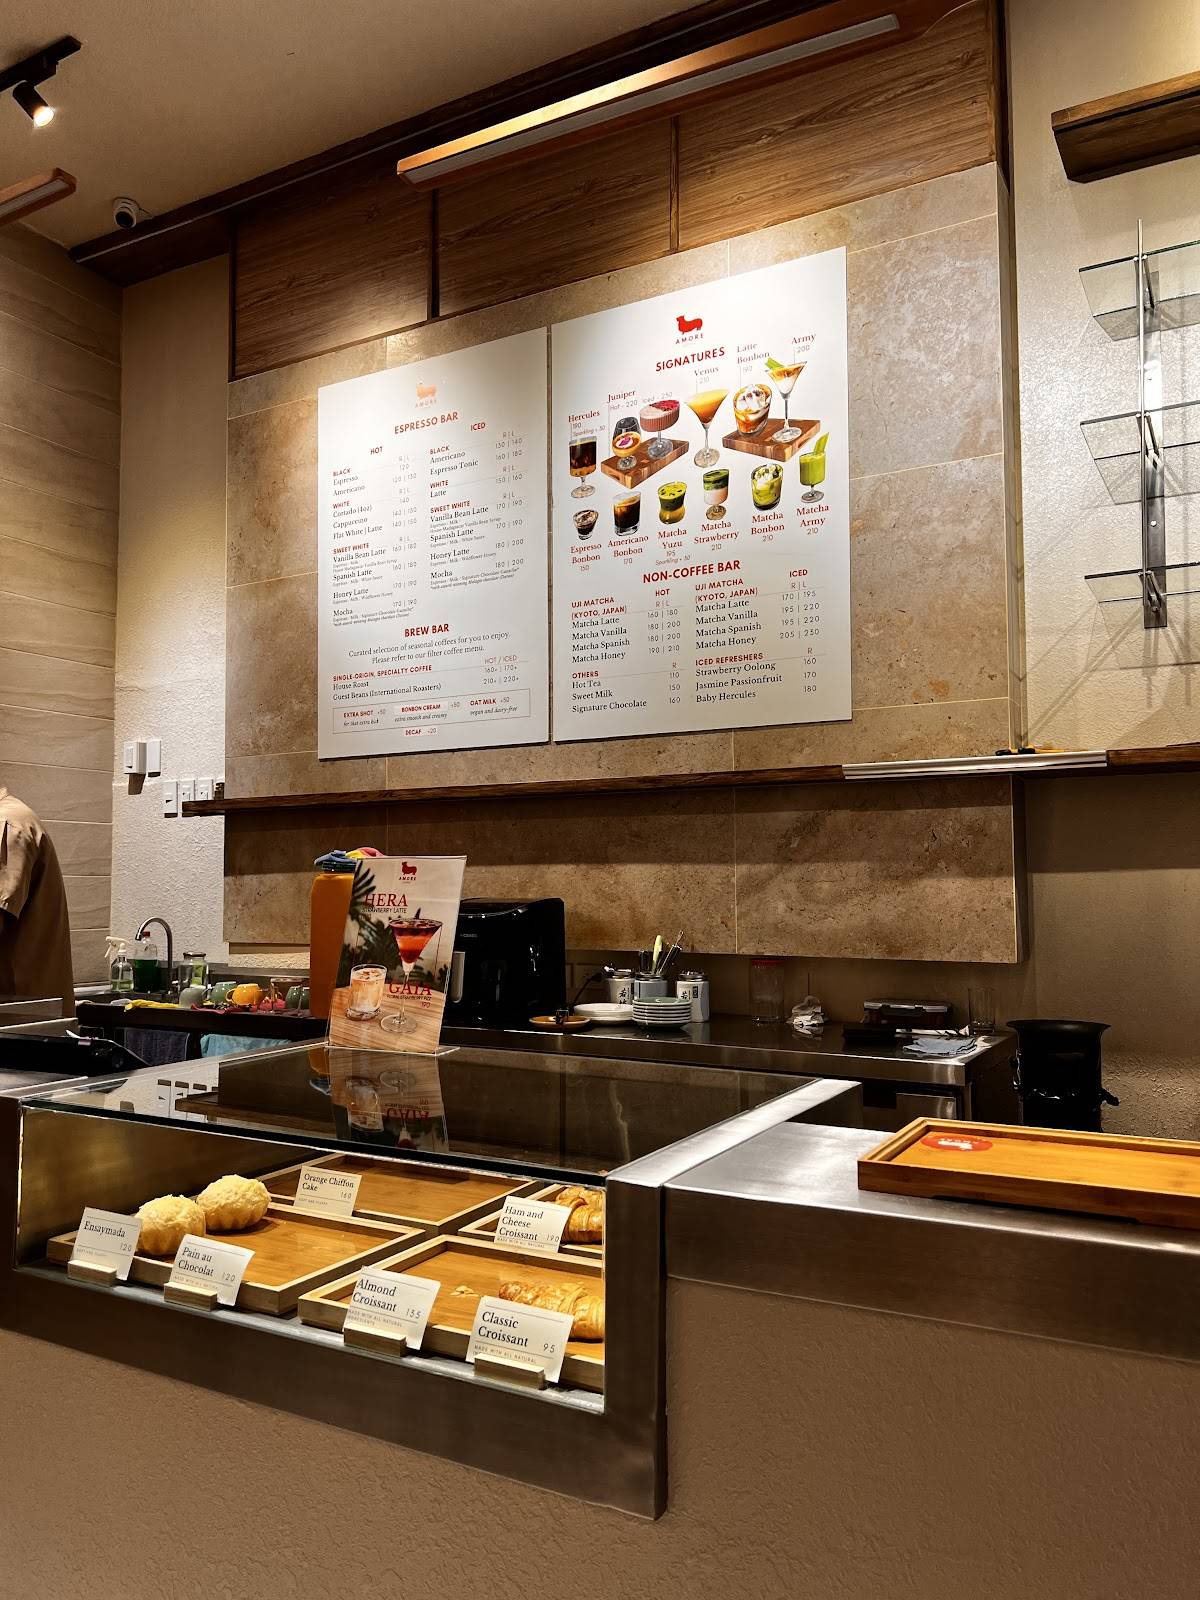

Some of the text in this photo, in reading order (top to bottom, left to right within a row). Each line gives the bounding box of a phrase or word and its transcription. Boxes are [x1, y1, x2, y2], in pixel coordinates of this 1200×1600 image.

[675, 333, 704, 345] AMORE
[792, 333, 816, 345] Army
[737, 342, 758, 353] Latte
[655, 347, 725, 372] SIGNATURES
[737, 351, 770, 364] Bonbon
[694, 366, 719, 376] Venus
[607, 390, 636, 403] Juniper
[394, 411, 458, 434] ESPRESSO BAR
[568, 410, 600, 423] Hercules
[471, 422, 486, 431] ICED
[370, 446, 383, 455] HOT
[430, 446, 450, 455] BLACK
[430, 452, 465, 464] Americano
[430, 459, 478, 476] Espresso Tonic
[430, 480, 449, 489] WHITE
[430, 490, 447, 498] Latte
[430, 500, 471, 513] SWEET WHITE
[796, 504, 829, 516] Matcha
[430, 506, 489, 522] Vanilla Bean Latte
[751, 512, 784, 523] Matcha
[701, 520, 732, 532] Matcha
[800, 517, 826, 527] Army
[430, 531, 455, 542] Spanish
[457, 528, 474, 537] Latte
[658, 528, 687, 539] Matcha
[751, 524, 785, 535] Bonbon
[807, 527, 819, 535] 210
[608, 535, 649, 548] Americano
[693, 530, 739, 544] Strawberry
[570, 543, 602, 554] Espresso
[662, 541, 683, 549] Yuzu
[711, 543, 722, 551] 210
[430, 552, 451, 561] Honey
[453, 548, 470, 556] Latte
[613, 547, 643, 558] Bonbon
[572, 554, 601, 564] Bonbon
[430, 570, 453, 579] Mocha
[643, 560, 741, 583] NON-COFFEE BAR
[789, 569, 808, 578] ICED
[708, 578, 744, 589] MATCHA
[333, 591, 352, 599] Honey
[655, 588, 670, 597] HOT
[695, 587, 758, 603] (KYOTO, JAPAN)
[583, 597, 615, 607] MATCHA
[695, 599, 750, 613] Matcha Latte
[803, 603, 820, 611] 220
[602, 605, 627, 615] JAPAN)
[572, 617, 620, 629] Matcha Latte
[695, 610, 758, 625] Matcha Vanilla
[803, 616, 820, 624] 220
[404, 624, 450, 637] BREW BAR
[572, 627, 627, 640] Matcha Vanilla
[695, 622, 762, 637] Matcha Spanish
[780, 631, 795, 639] 205
[572, 638, 630, 652] Matcha Spanish
[695, 635, 757, 649] Matcha Honey
[572, 651, 626, 664] Matcha Honey
[715, 653, 763, 664] REFRESHERS
[377, 667, 408, 677] SPECIALTY
[409, 664, 432, 673] COFFEE
[572, 671, 599, 679] OTHERS
[695, 662, 776, 677] Strawberry Oolong
[333, 681, 369, 691] House Roast
[572, 679, 601, 689] Hot Tea
[696, 674, 782, 691] Jasmine Passionfruit
[370, 683, 441, 697] (International Roasters)
[804, 685, 817, 693] 180
[572, 690, 613, 701] Sweet Milk
[669, 697, 680, 705] 160
[696, 690, 757, 704] Baby Hercules
[572, 700, 647, 714] Signature Chocolate
[364, 893, 408, 907] HERA
[389, 981, 432, 996] GAIA
[304, 1173, 354, 1188] Orange Chiffon
[302, 1183, 318, 1191] Cake
[340, 1192, 352, 1200] 160
[504, 1206, 544, 1219] Ham and
[501, 1216, 531, 1228] Cheese
[83, 1220, 126, 1238] Ensaymada
[499, 1227, 560, 1243] Croissant 190
[119, 1242, 132, 1252] 120
[182, 1246, 212, 1263] Pain au
[178, 1259, 236, 1282] Chocolat 120
[356, 1278, 397, 1297] Almond
[352, 1292, 397, 1312] Croissant
[482, 1311, 519, 1329] Classic
[478, 1326, 556, 1353] Croissant 95
